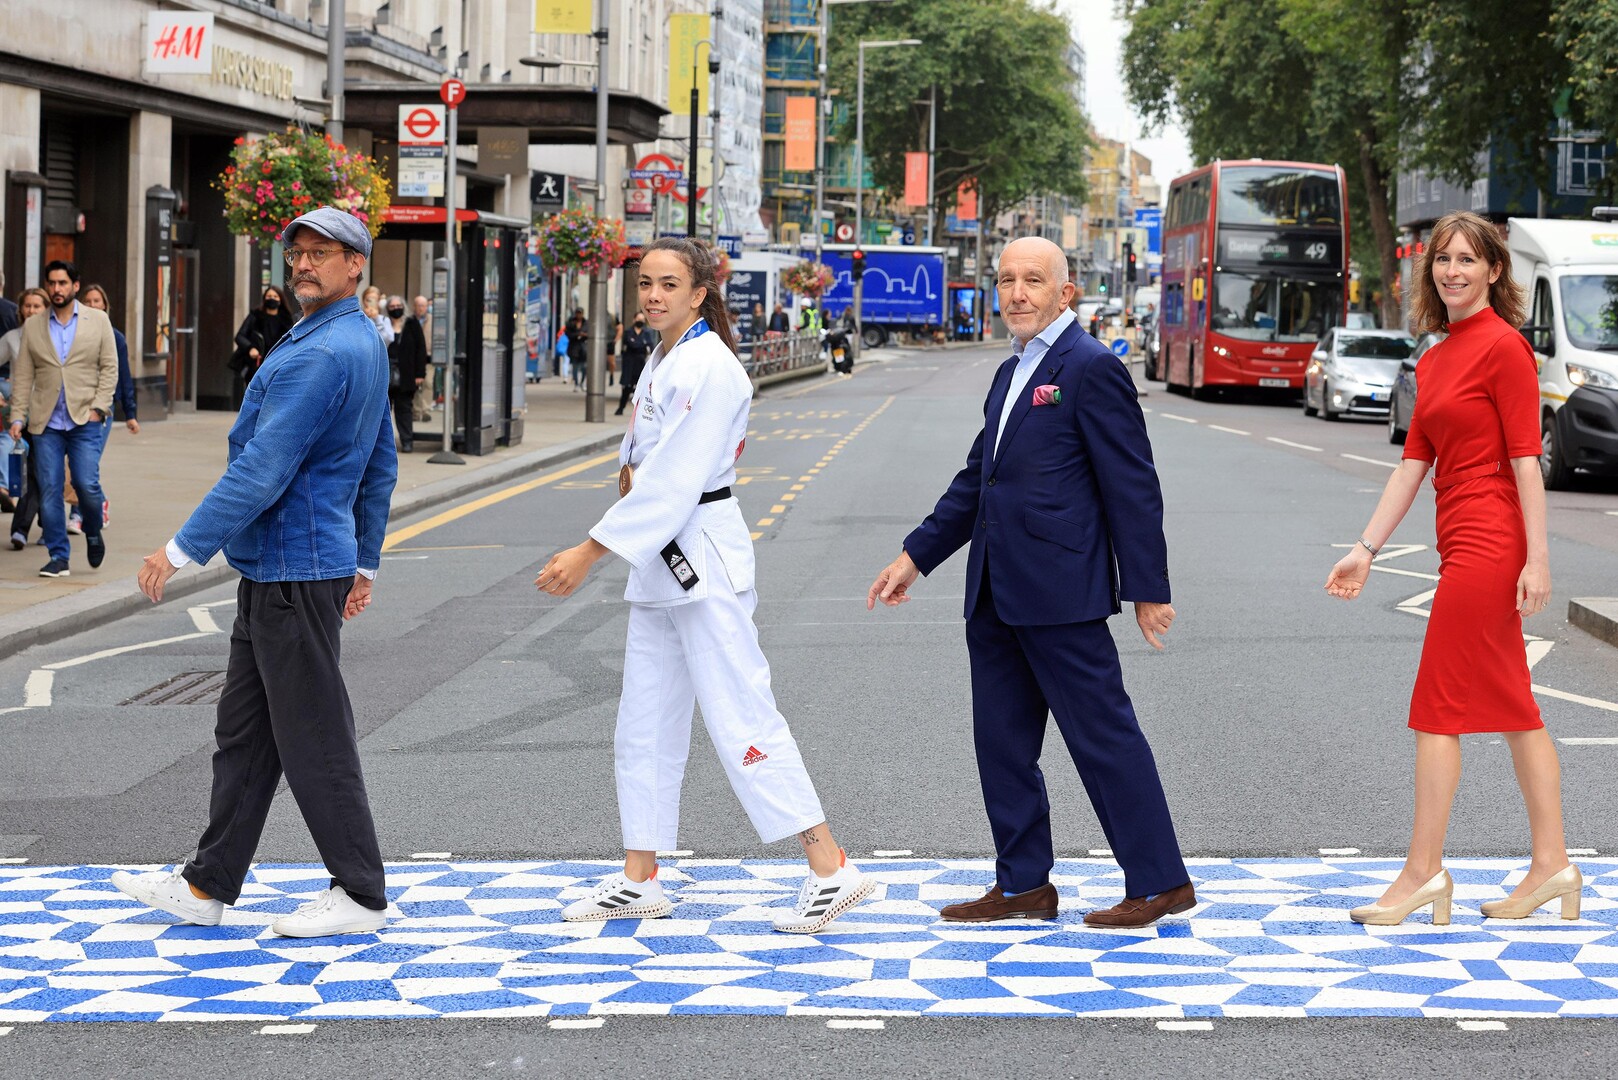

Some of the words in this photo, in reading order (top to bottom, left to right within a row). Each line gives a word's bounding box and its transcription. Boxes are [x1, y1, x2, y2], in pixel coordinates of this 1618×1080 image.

[153, 24, 206, 60] H&M
[448, 83, 461, 102] F
[653, 176, 662, 187] E
[1304, 243, 1327, 259] 49
[728, 291, 749, 301] Open
[742, 753, 769, 767] adidas
